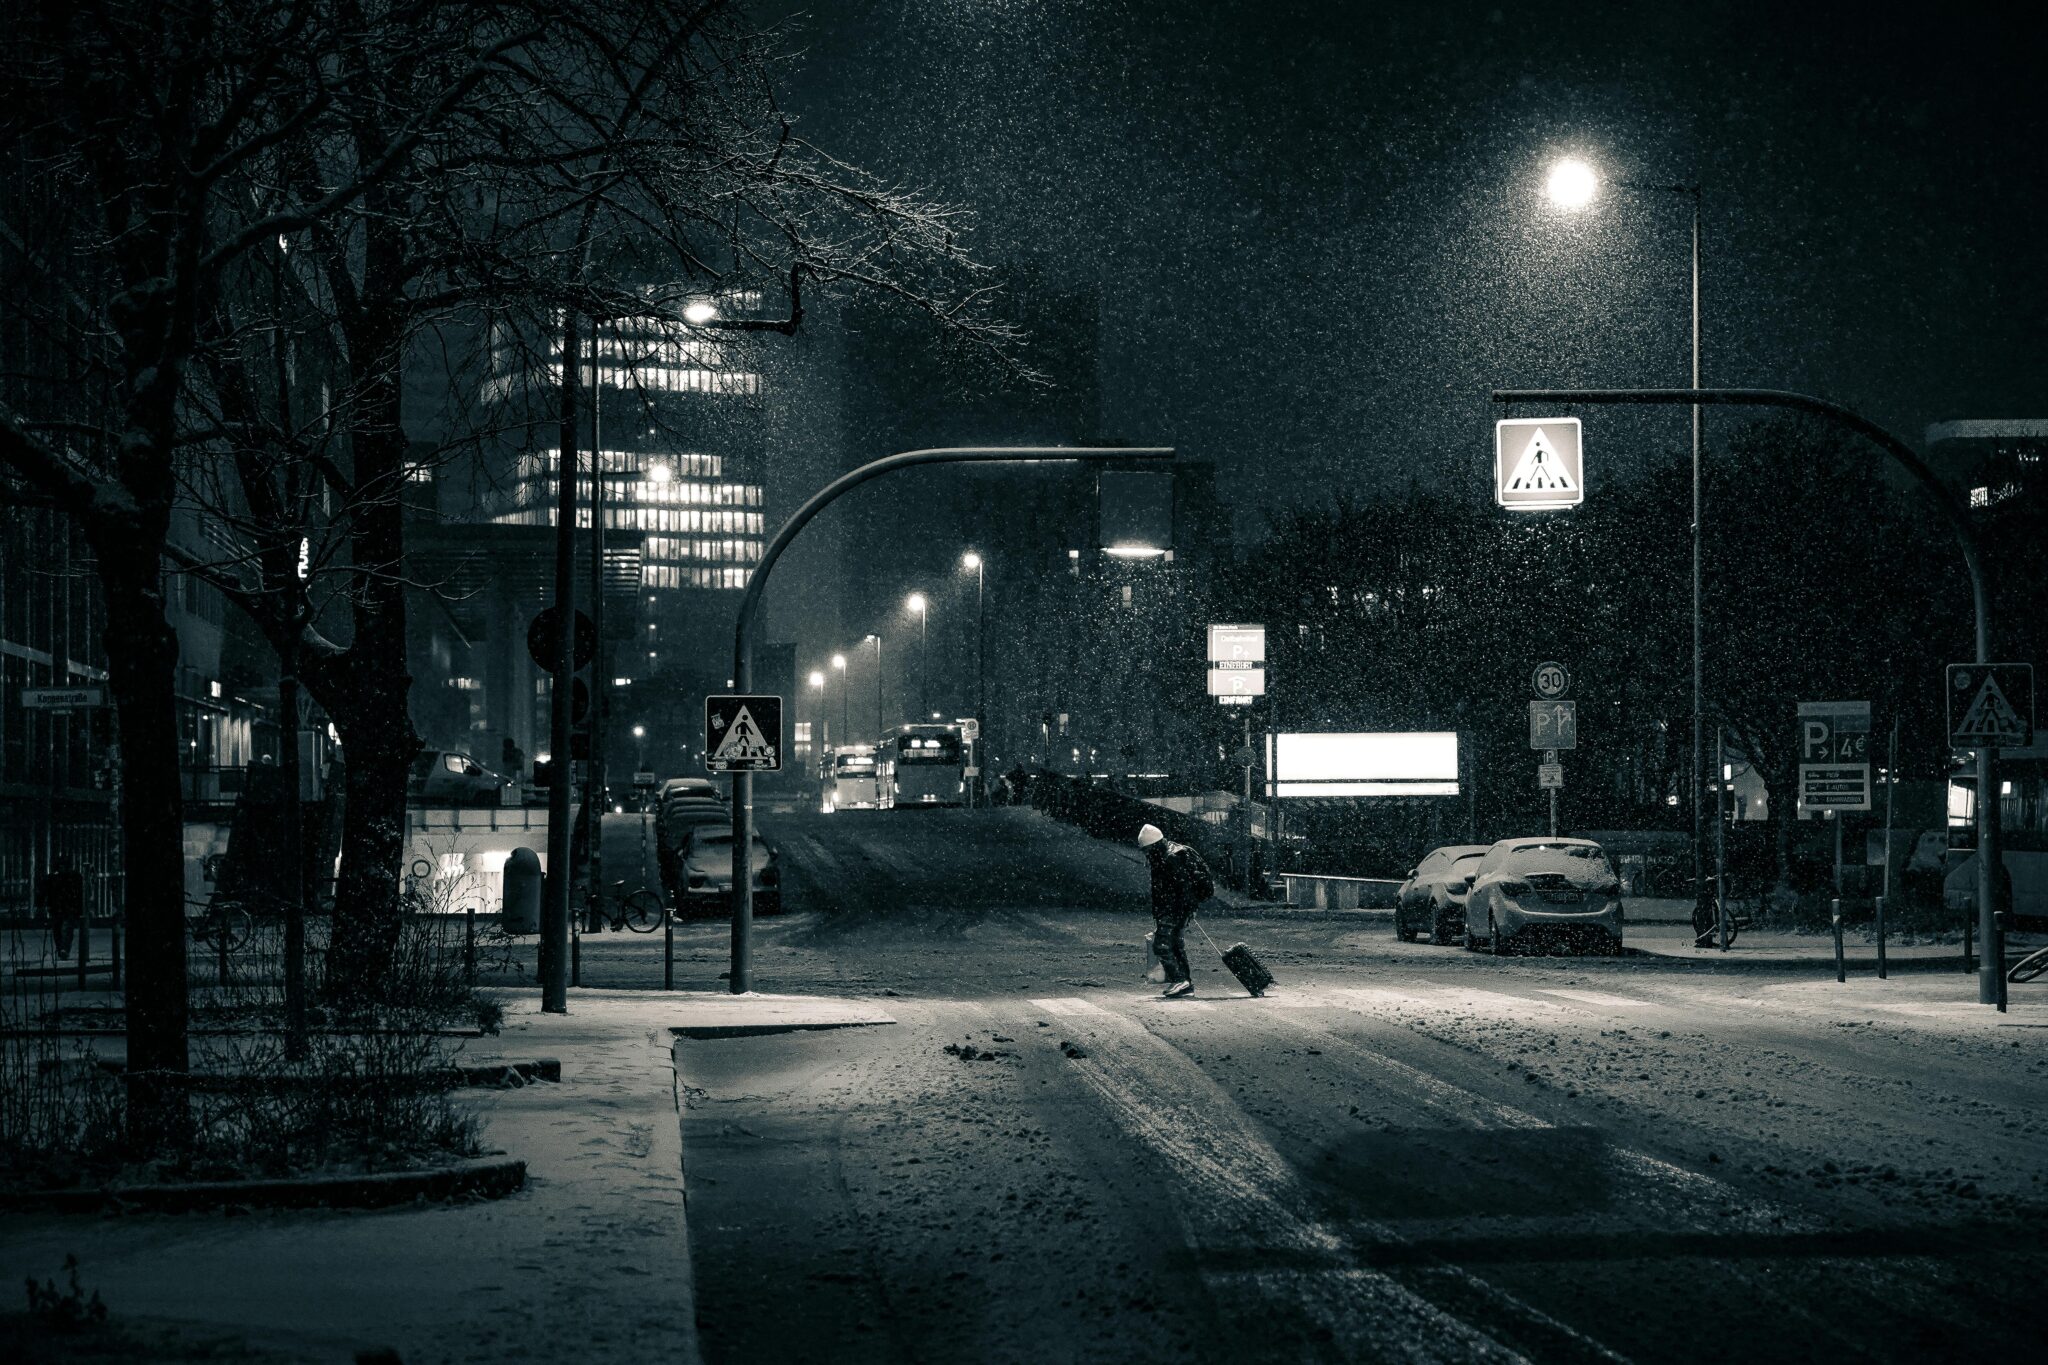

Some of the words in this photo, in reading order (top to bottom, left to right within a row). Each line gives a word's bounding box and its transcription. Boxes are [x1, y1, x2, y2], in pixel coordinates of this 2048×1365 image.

[1540, 673, 1562, 690] 30
[1536, 713, 1550, 736] P
[1804, 721, 1829, 758] P
